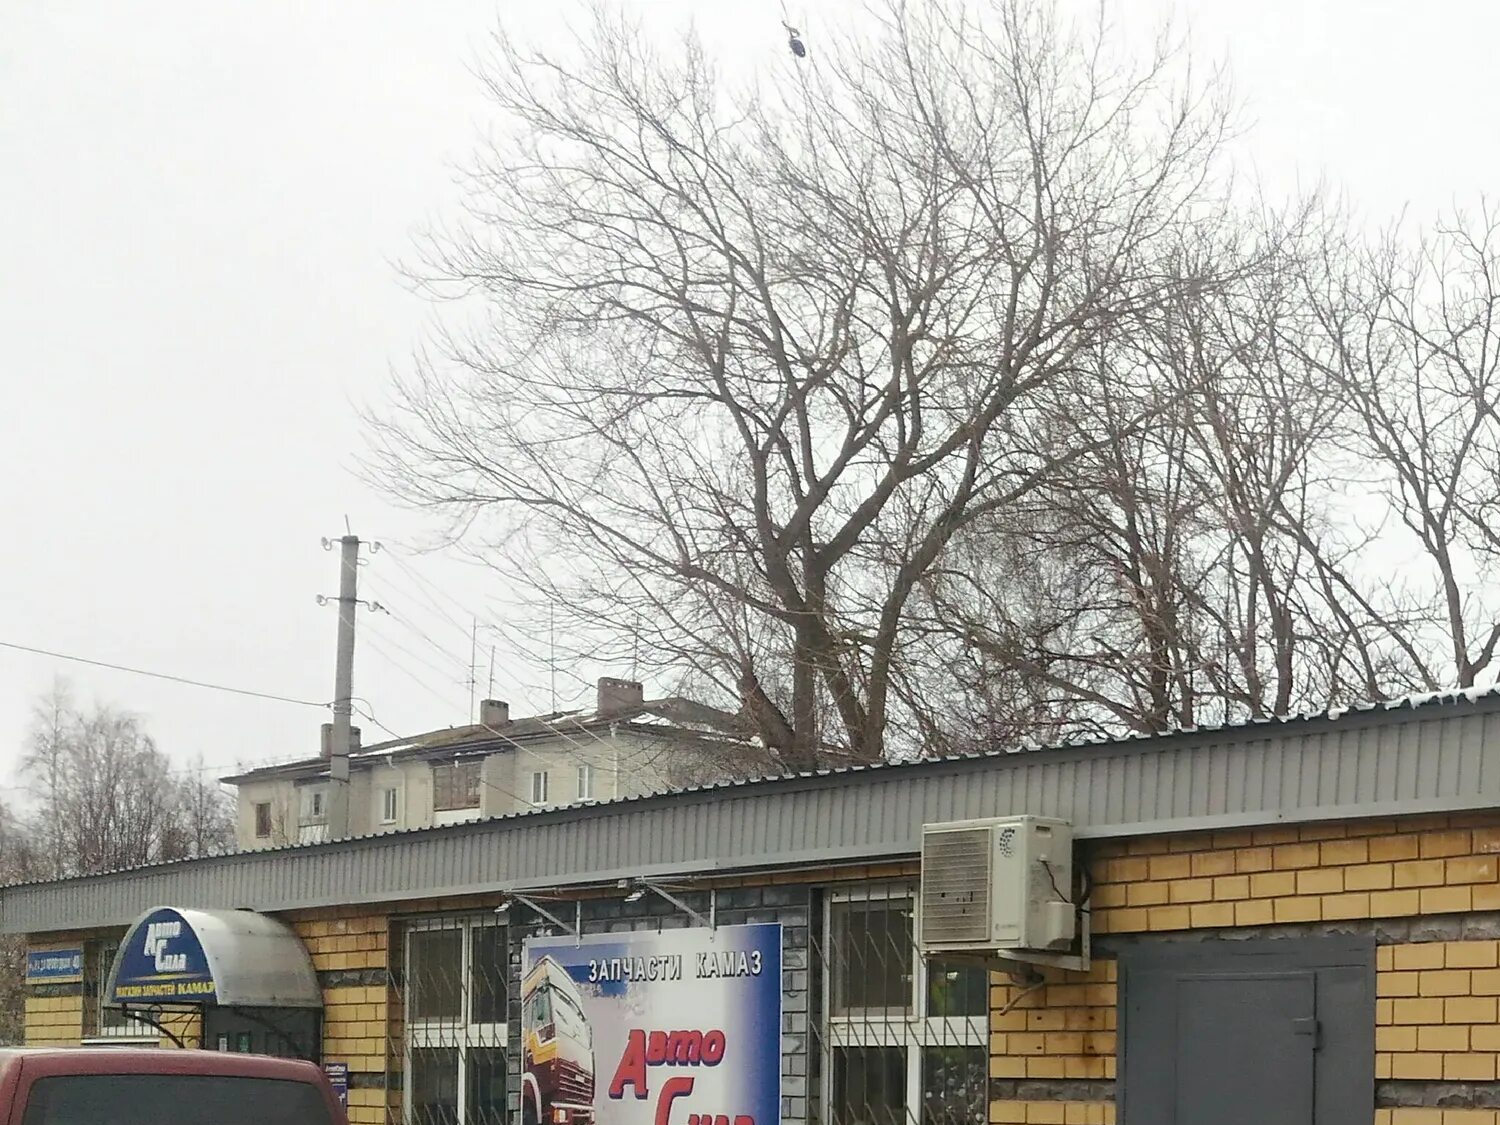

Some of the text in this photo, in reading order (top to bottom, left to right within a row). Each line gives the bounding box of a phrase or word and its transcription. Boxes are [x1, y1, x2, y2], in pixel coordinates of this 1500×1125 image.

[588, 950, 763, 983] ЗАПЧАСТИ КАМАЗ
[608, 1029, 726, 1100] Авто
